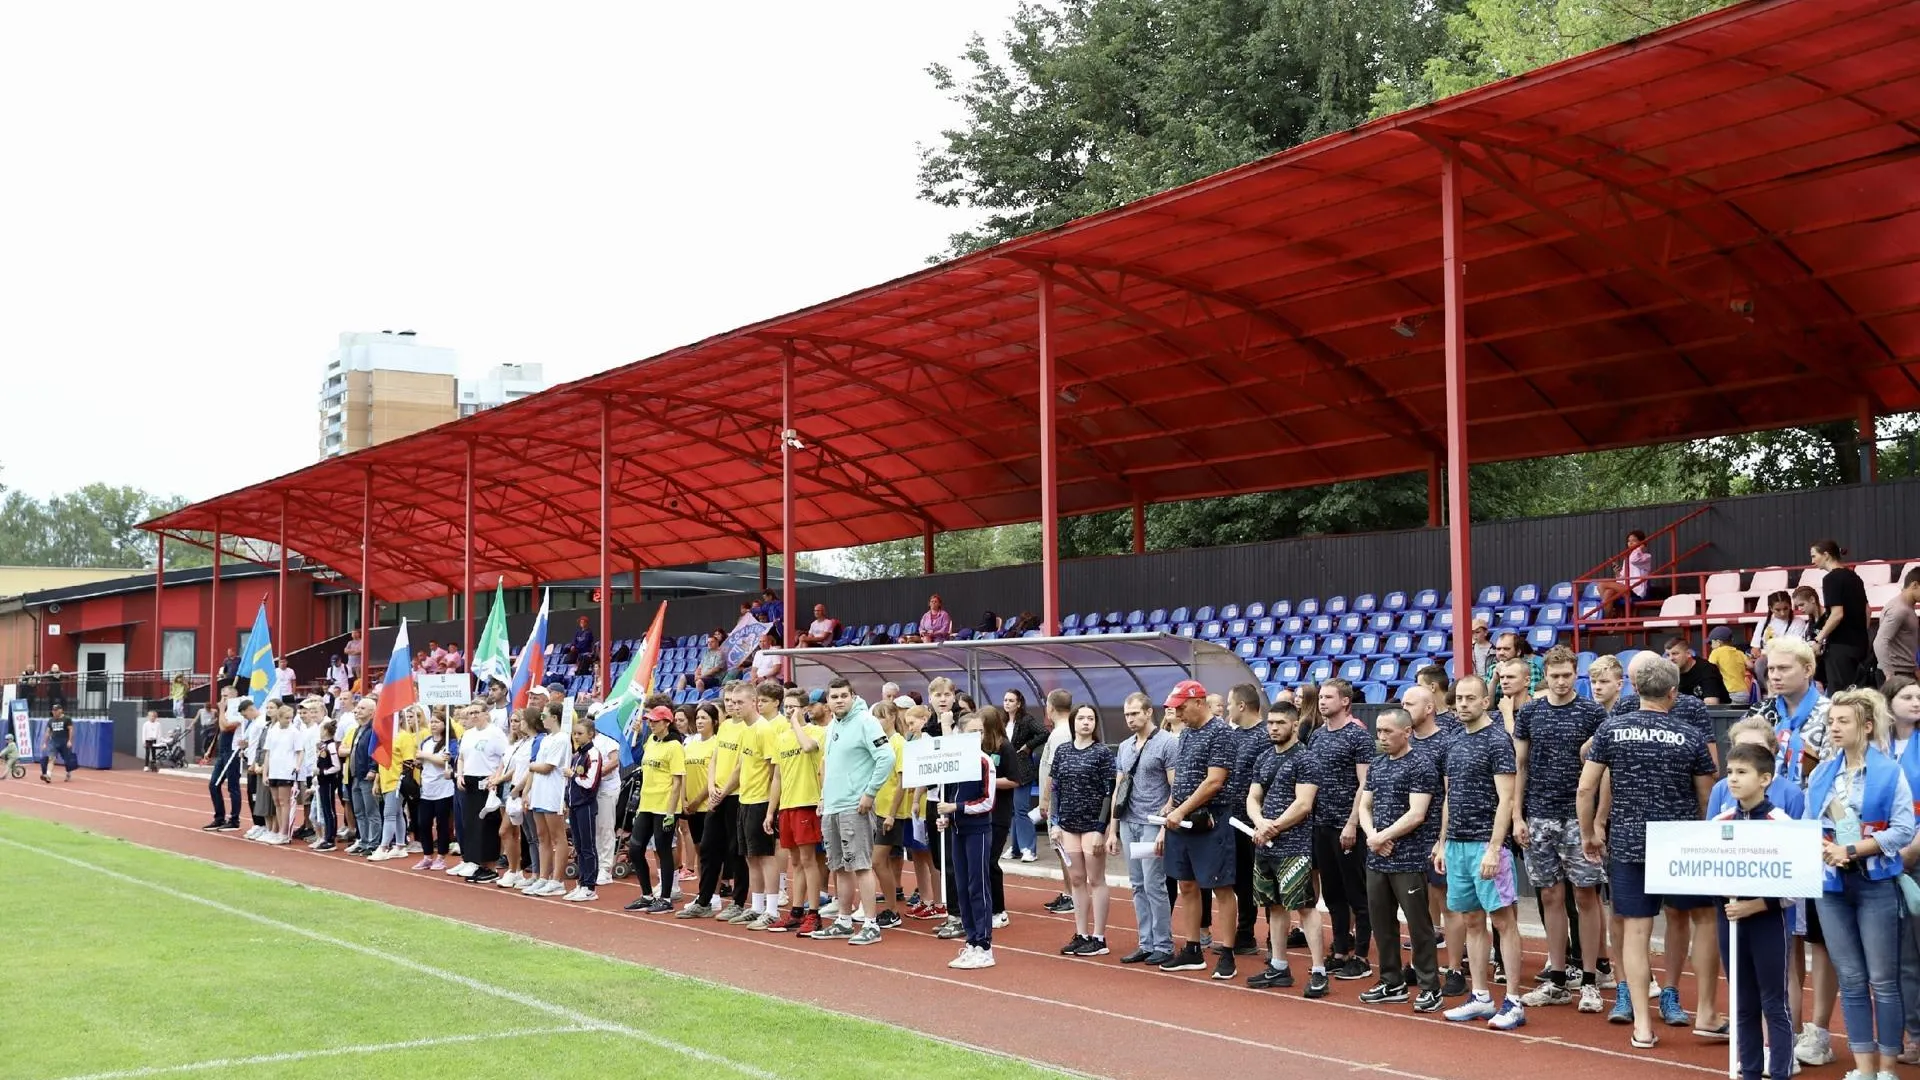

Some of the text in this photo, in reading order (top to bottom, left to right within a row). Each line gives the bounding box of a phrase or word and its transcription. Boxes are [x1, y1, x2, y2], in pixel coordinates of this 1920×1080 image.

[1613, 727, 1685, 746] ПОВАРОВО
[918, 760, 960, 776] ПОВАРОВО
[1669, 860, 1793, 879] СМИРНОВСКОЕ
